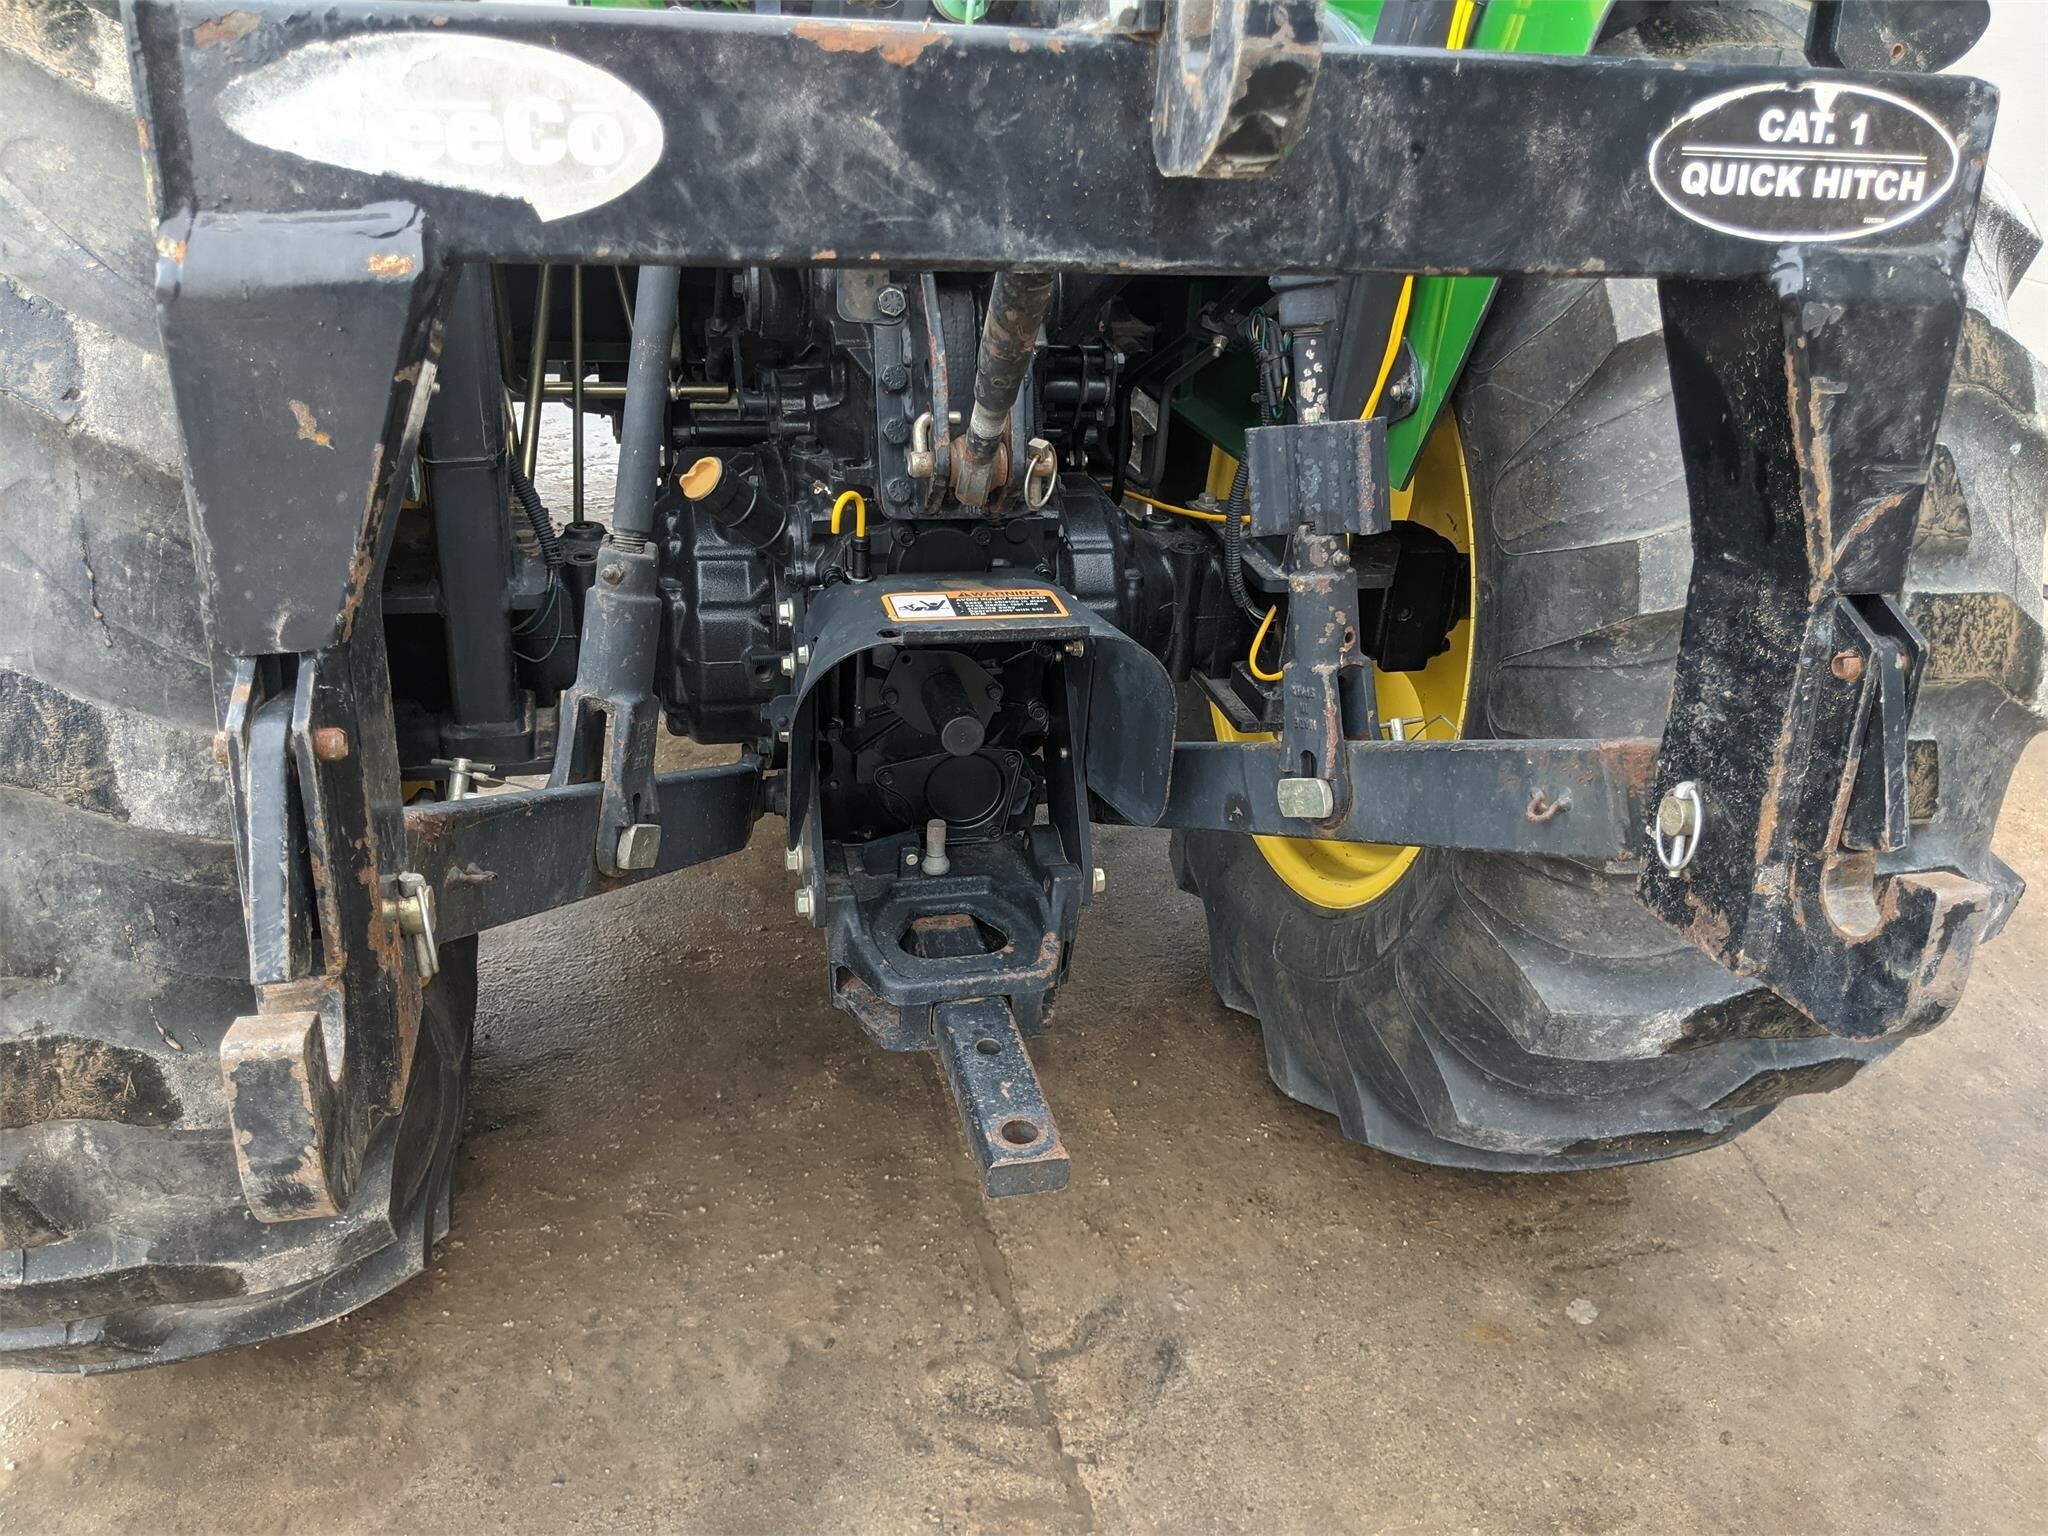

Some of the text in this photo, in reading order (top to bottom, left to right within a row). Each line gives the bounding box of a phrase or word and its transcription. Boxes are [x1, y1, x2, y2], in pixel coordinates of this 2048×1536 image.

[1758, 109, 1869, 145] CAT. 1
[1680, 162, 1926, 201] QUICK HITCH
